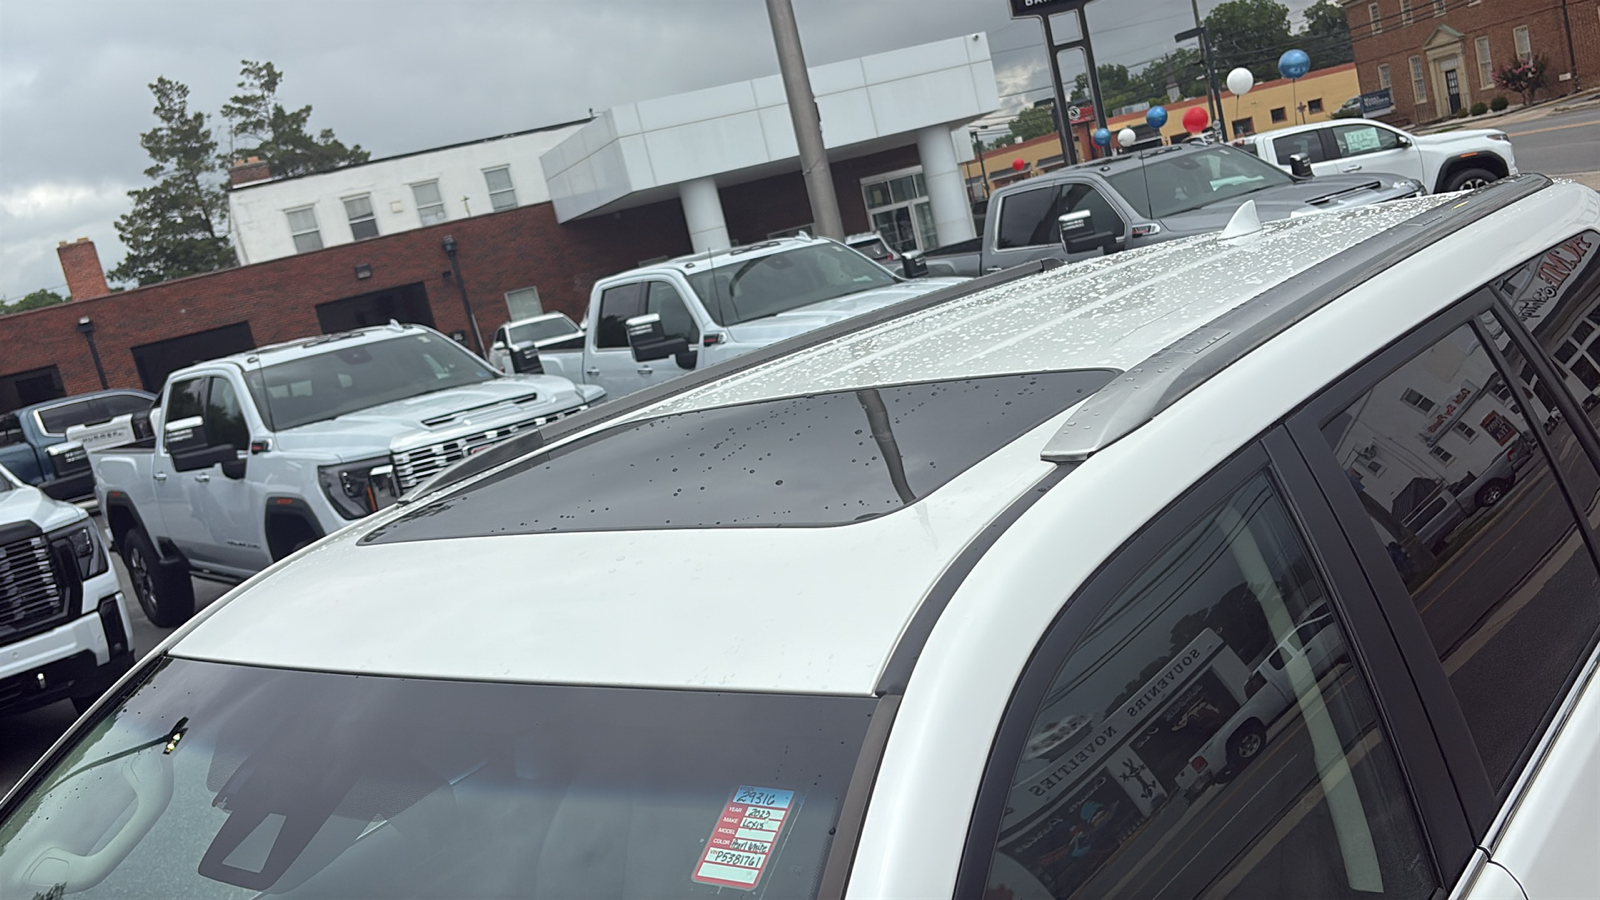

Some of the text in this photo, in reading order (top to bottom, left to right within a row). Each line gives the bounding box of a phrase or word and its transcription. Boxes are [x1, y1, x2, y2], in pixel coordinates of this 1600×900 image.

[736, 790, 776, 806] 29316
[723, 816, 739, 824] MAKE
[718, 827, 735, 835] MODEL
[715, 850, 761, 868] P5381761
